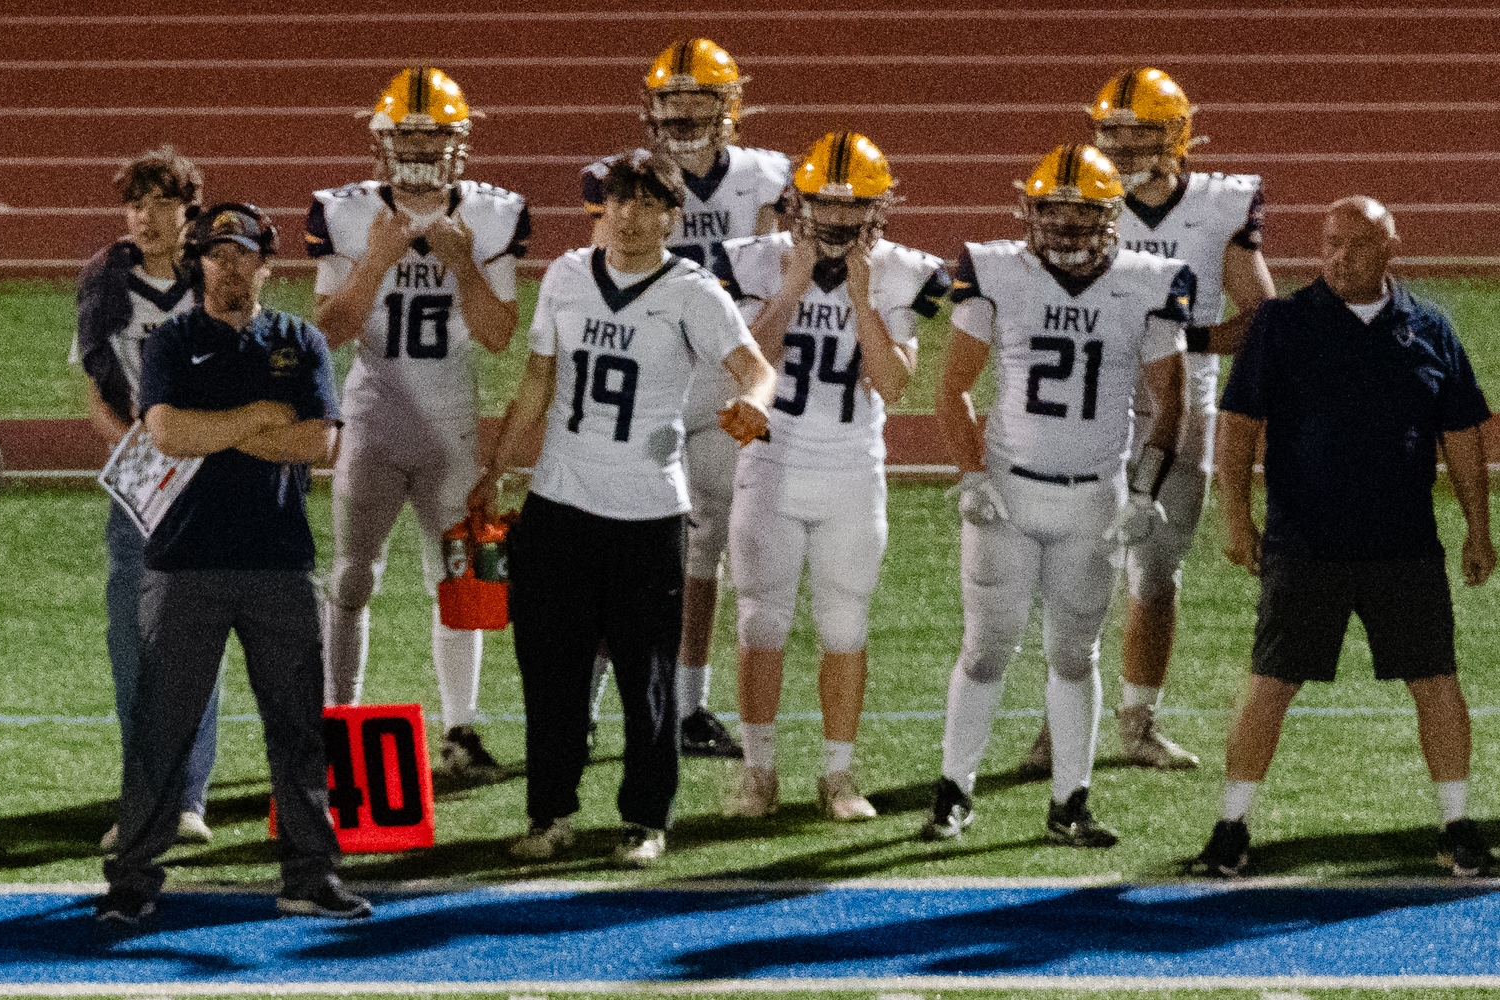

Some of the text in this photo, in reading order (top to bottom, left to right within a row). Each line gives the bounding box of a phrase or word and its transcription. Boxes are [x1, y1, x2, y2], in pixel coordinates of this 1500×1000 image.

[683, 210, 730, 238] HRV
[396, 263, 448, 288] HRV
[798, 300, 852, 330] HRV
[1044, 304, 1100, 333] HRV
[582, 317, 636, 351] HRV
[772, 333, 862, 423] 34
[1026, 335, 1104, 420] 21
[567, 348, 639, 442] 19
[323, 716, 424, 829] 40
